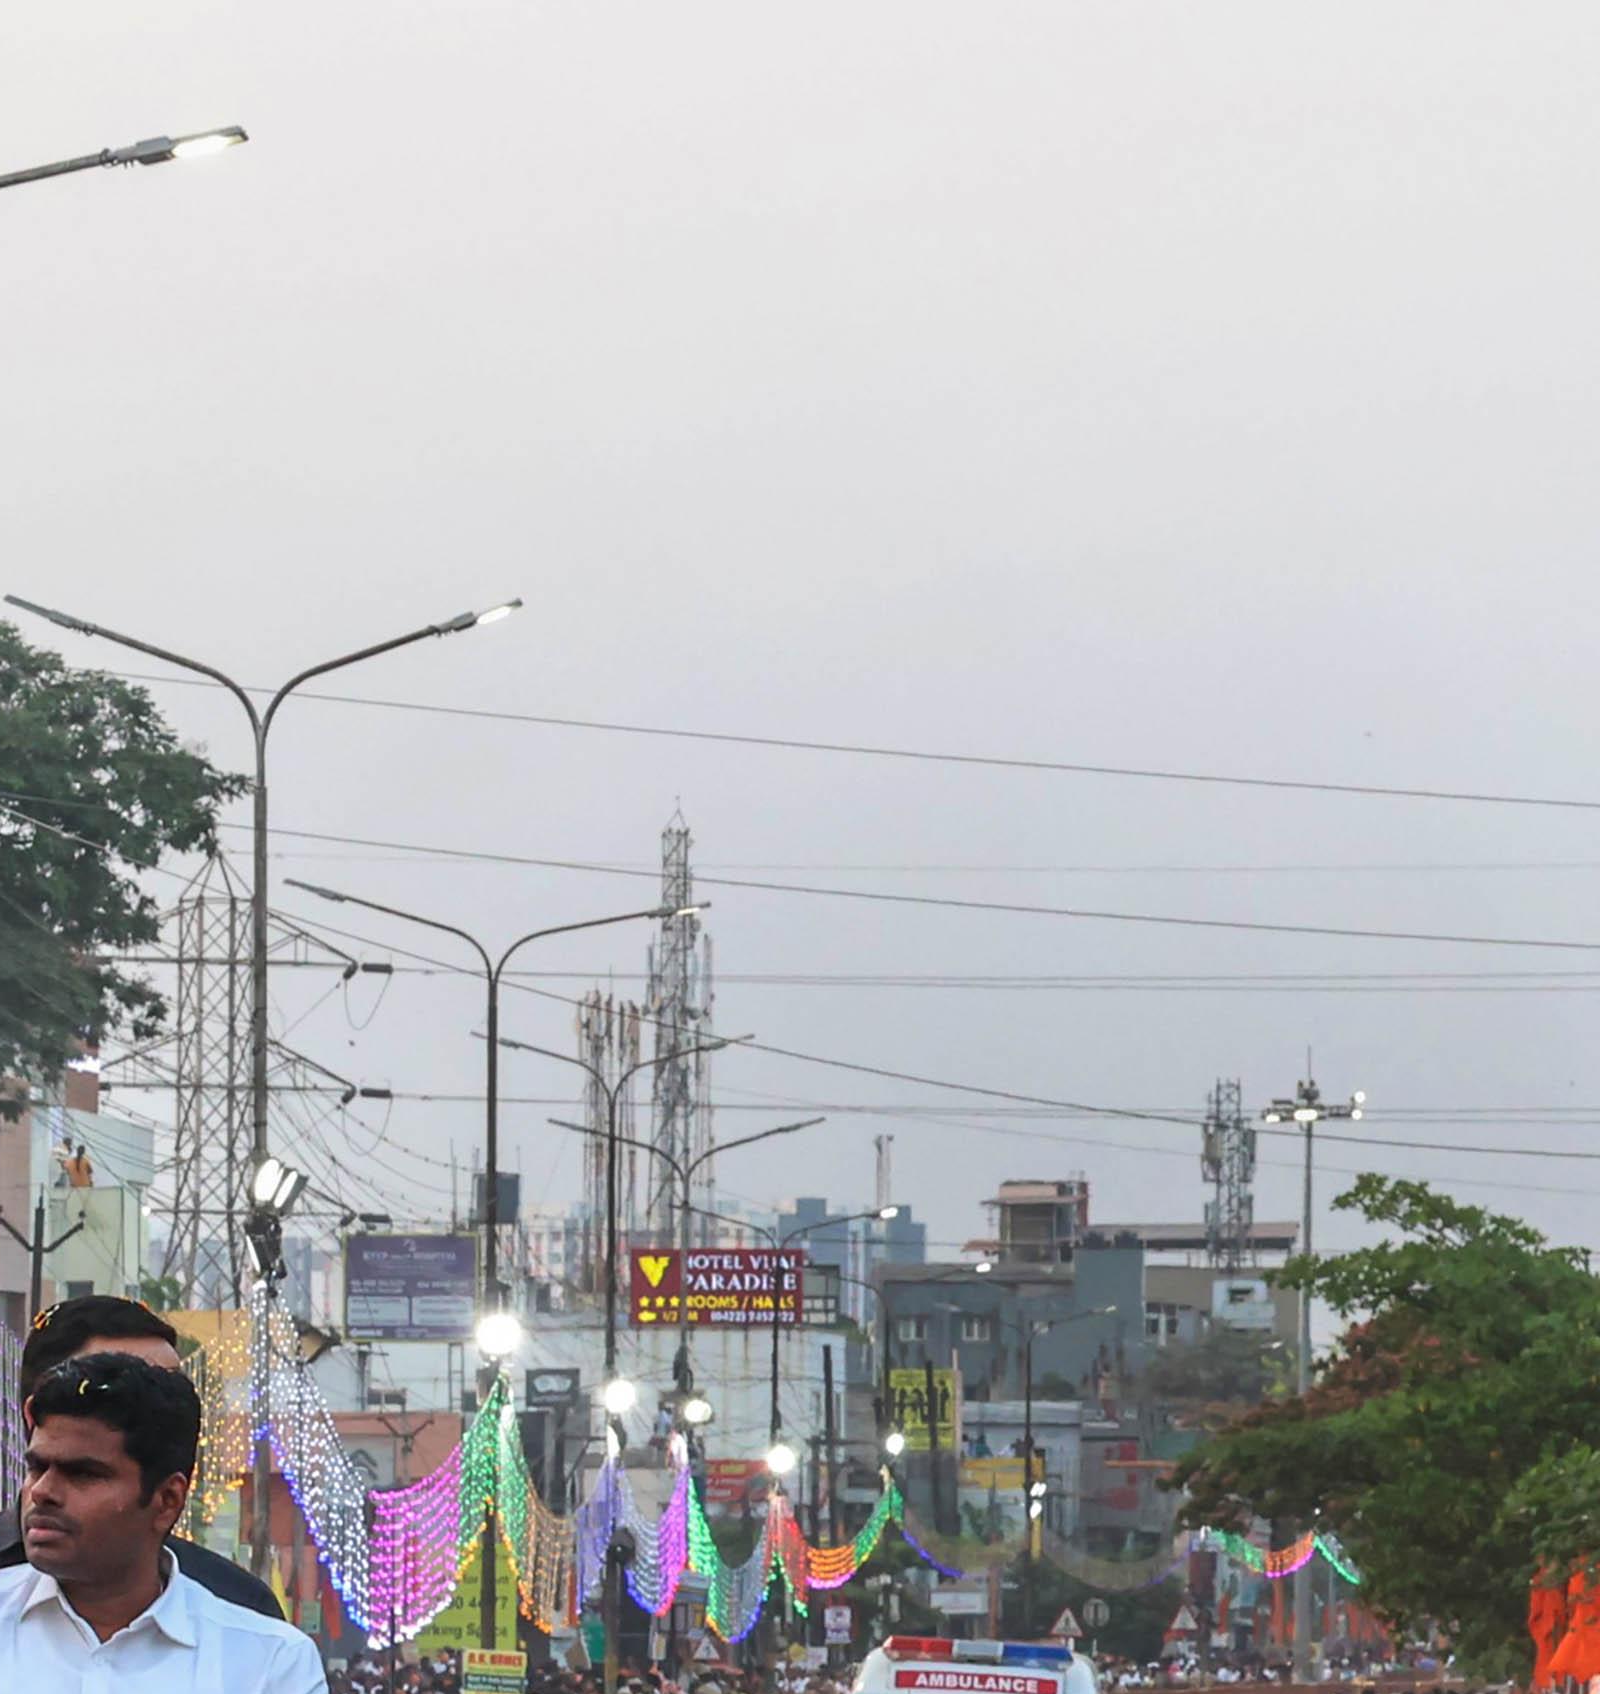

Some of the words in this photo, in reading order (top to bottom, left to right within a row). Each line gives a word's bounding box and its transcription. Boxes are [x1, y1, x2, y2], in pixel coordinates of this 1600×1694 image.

[687, 1254, 743, 1270] HOTEL
[686, 1295, 738, 1309] ROOMS
[915, 1673, 1039, 1694] AMBULANCE
